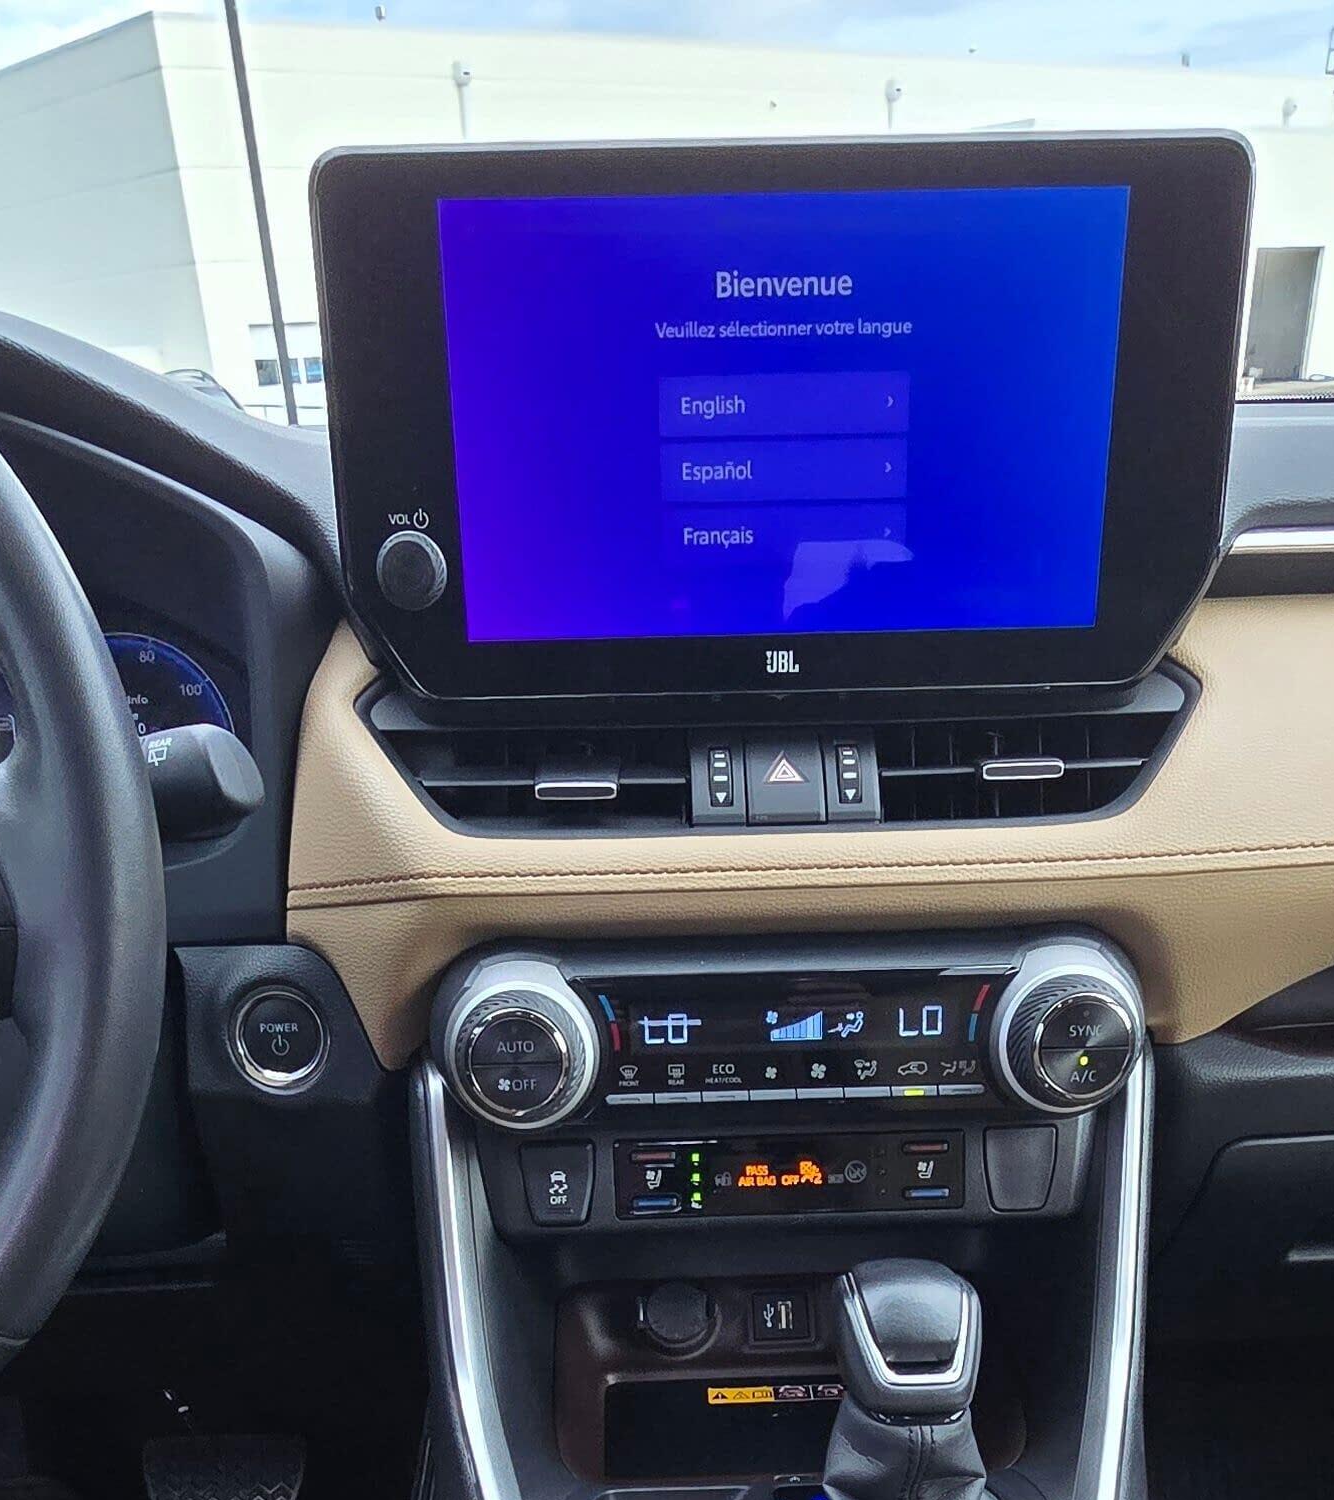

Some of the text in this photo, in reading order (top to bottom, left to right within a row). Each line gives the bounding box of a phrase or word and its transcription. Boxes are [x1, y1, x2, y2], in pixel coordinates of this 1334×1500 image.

[716, 270, 853, 298] Bienvenue
[655, 318, 913, 338] Veuillez sélectionner votre langue
[681, 395, 745, 420] English
[682, 460, 753, 484] Español
[388, 514, 411, 525] VOL
[683, 526, 754, 549] Français
[139, 650, 156, 663] 80
[765, 650, 800, 673] JBL
[179, 683, 203, 697] 100
[148, 738, 173, 749] REAR
[259, 1023, 299, 1032] POWER
[1069, 1023, 1102, 1036] SYNC
[496, 1040, 535, 1053] AUTO
[712, 1063, 735, 1075] ECO
[1070, 1070, 1097, 1084] A/C
[512, 1078, 538, 1092] OFF
[745, 1165, 769, 1176] PASS
[756, 1175, 777, 1186] BAG
[781, 1174, 800, 1185] OFF
[550, 1196, 567, 1205] OFF
